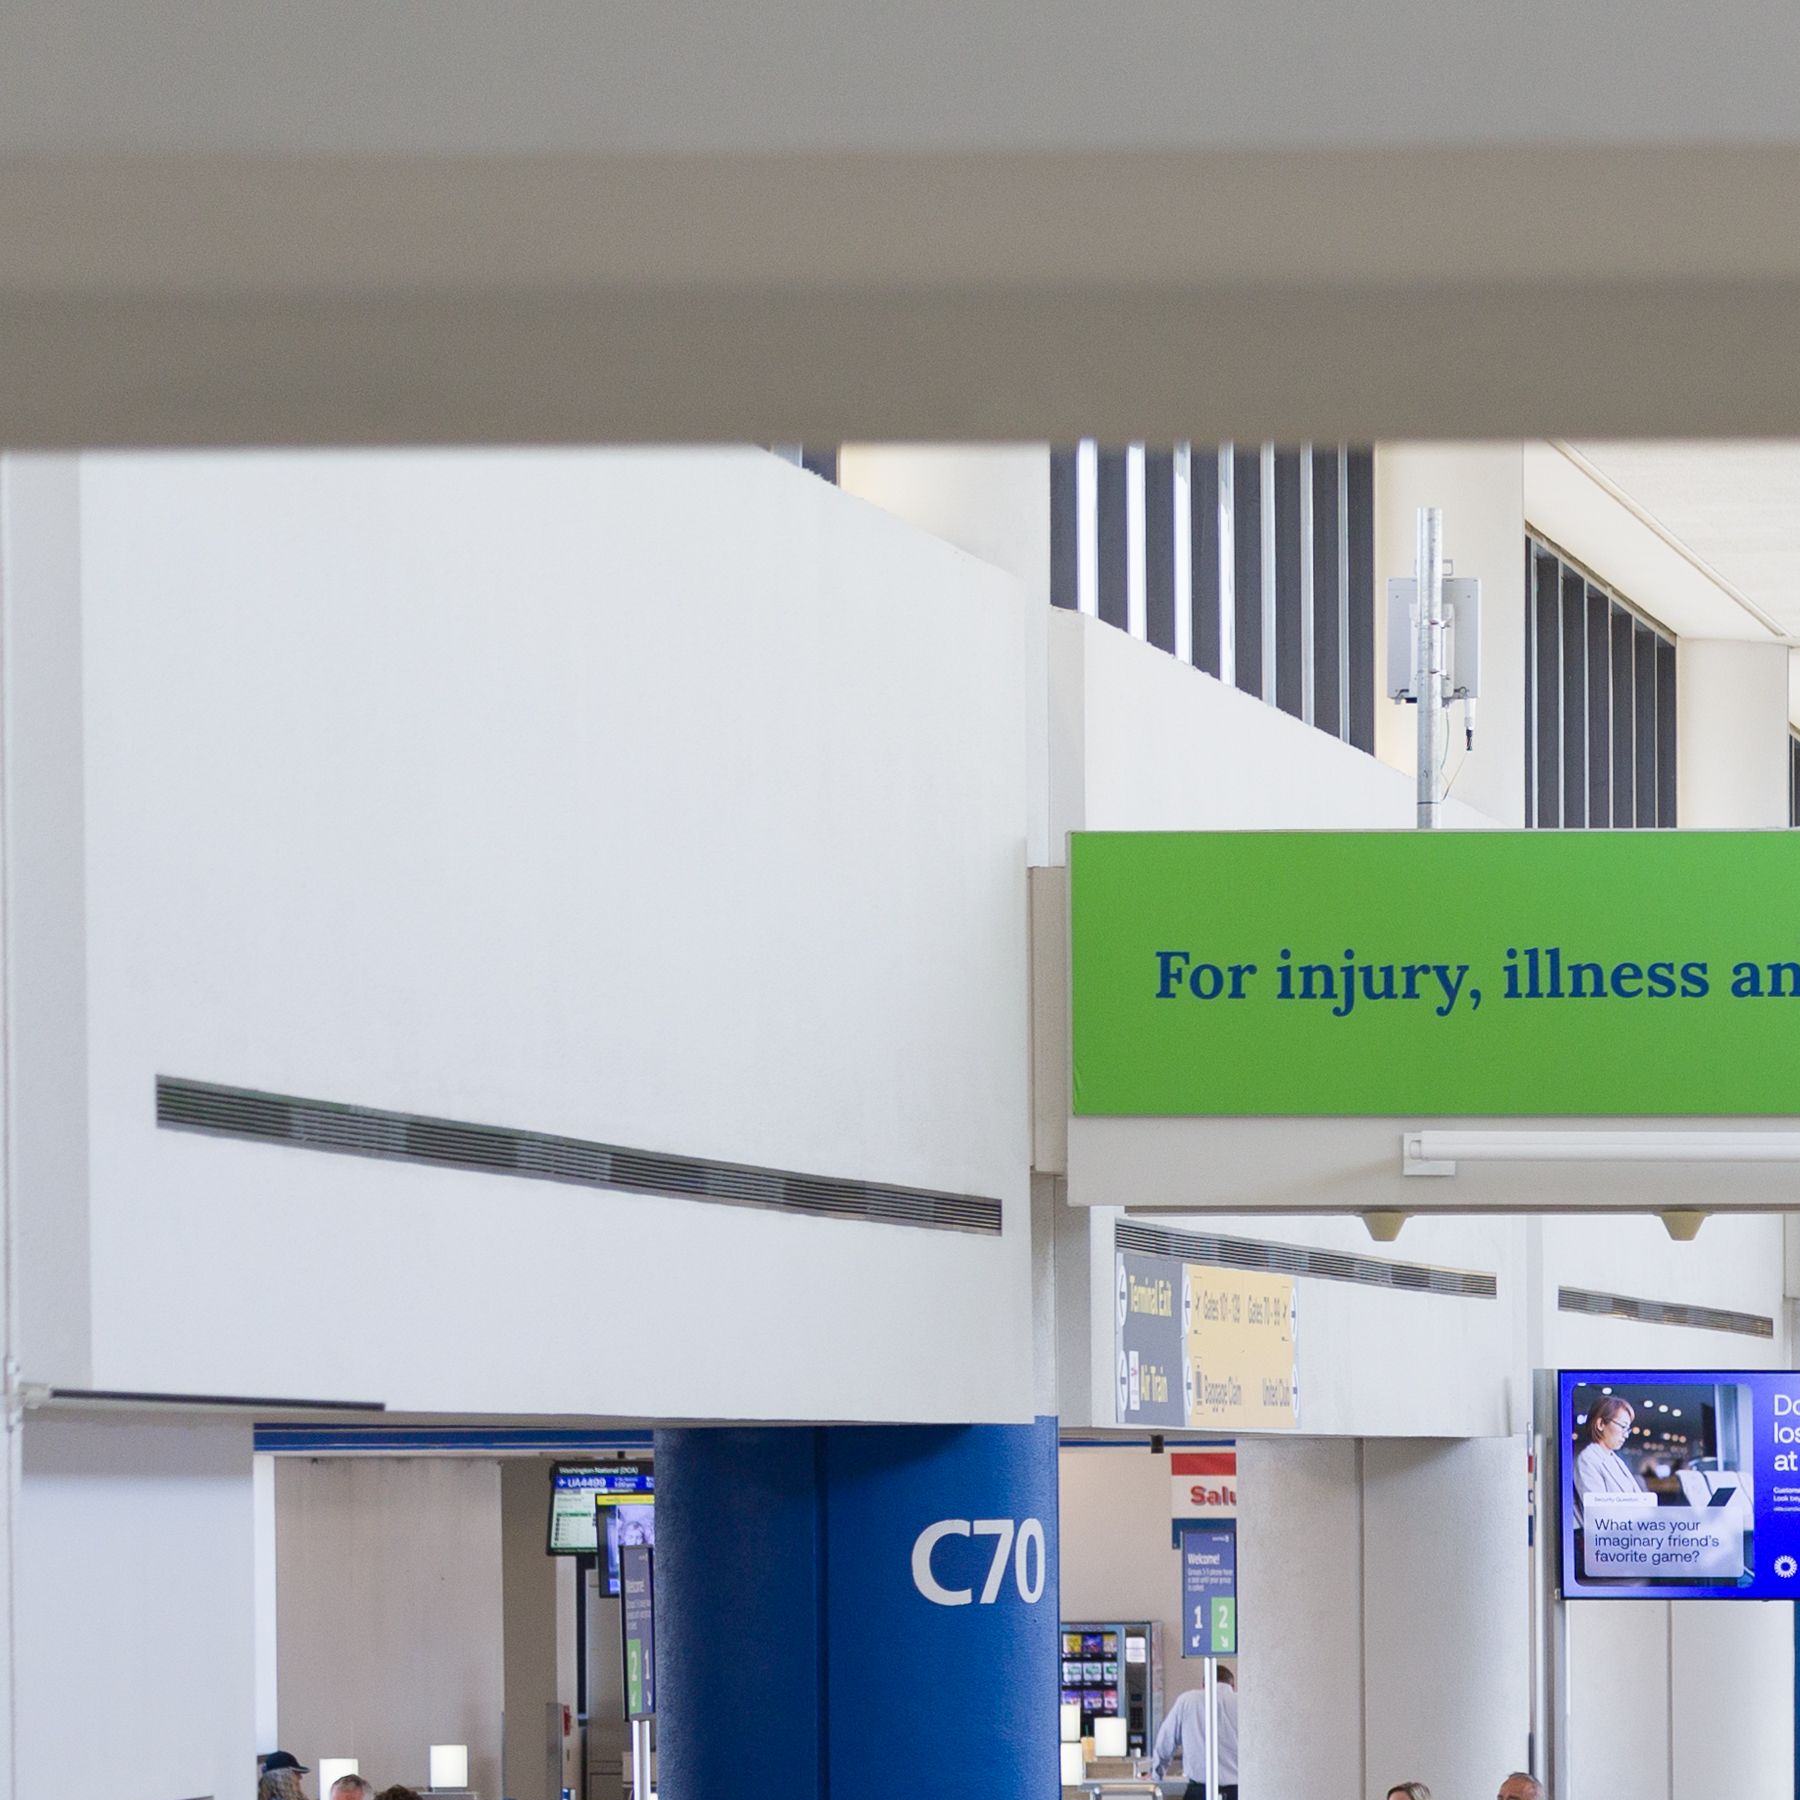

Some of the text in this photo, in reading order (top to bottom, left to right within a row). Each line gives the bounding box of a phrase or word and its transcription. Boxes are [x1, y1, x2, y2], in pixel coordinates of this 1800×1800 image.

[1156, 951, 1257, 1000] For
[1277, 949, 1482, 1018] injury,
[1504, 947, 1711, 999] illness
[1129, 1275, 1172, 1317] Terminal Exit
[1204, 1290, 1219, 1321] Gates
[1249, 1295, 1263, 1325] Gates
[1204, 1375, 1242, 1413] Baggage Claim
[1263, 1378, 1290, 1407] United Club
[1773, 1450, 1799, 1472] at
[1594, 1518, 1701, 1534] What was your
[1594, 1534, 1720, 1550] imaginary friend's
[912, 1519, 1046, 1607] C70
[1187, 1553, 1221, 1565] Welcome!
[1595, 1550, 1700, 1565] favorite game?
[1194, 1604, 1229, 1629] 1 2
[631, 1650, 638, 1682] 2
